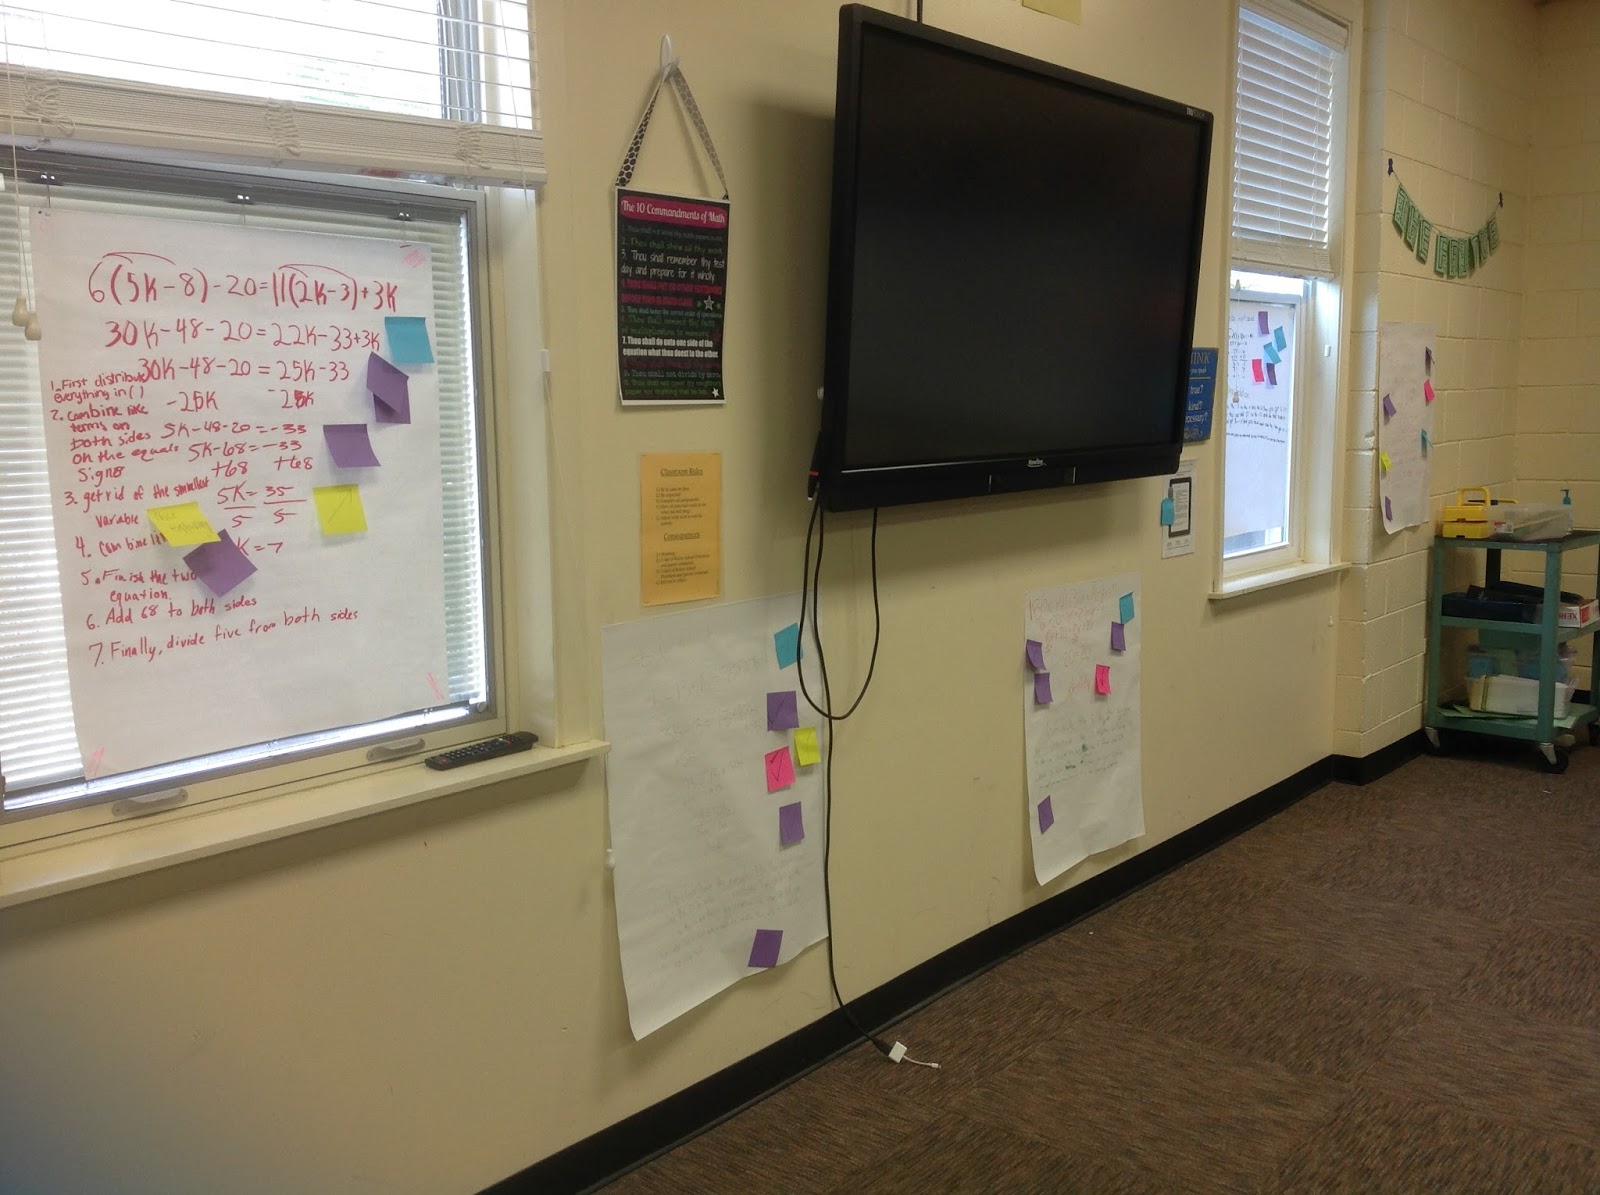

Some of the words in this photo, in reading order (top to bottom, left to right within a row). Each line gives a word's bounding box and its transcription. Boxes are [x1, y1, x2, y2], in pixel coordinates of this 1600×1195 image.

[620, 200, 634, 212] The
[636, 202, 646, 214] 10
[646, 203, 700, 220] Commandments
[700, 211, 708, 224] of
[708, 210, 725, 224] Math
[61, 377, 88, 390] First
[69, 421, 108, 434] terms
[112, 422, 131, 432] on
[118, 431, 152, 447] sides
[97, 451, 126, 463] the
[64, 491, 79, 506] 3.
[133, 485, 144, 500] of
[74, 535, 92, 559] 4.
[86, 613, 100, 631] 6.
[105, 607, 134, 626] Add
[140, 604, 158, 620] 68
[167, 602, 184, 618] to
[189, 597, 216, 617] both
[224, 595, 258, 612] sides
[88, 641, 105, 667] 7.
[110, 635, 164, 663] Finally,
[166, 633, 206, 650] divide
[214, 623, 243, 642] five
[247, 619, 277, 634] from
[282, 606, 321, 627] both
[329, 608, 360, 622] sides
